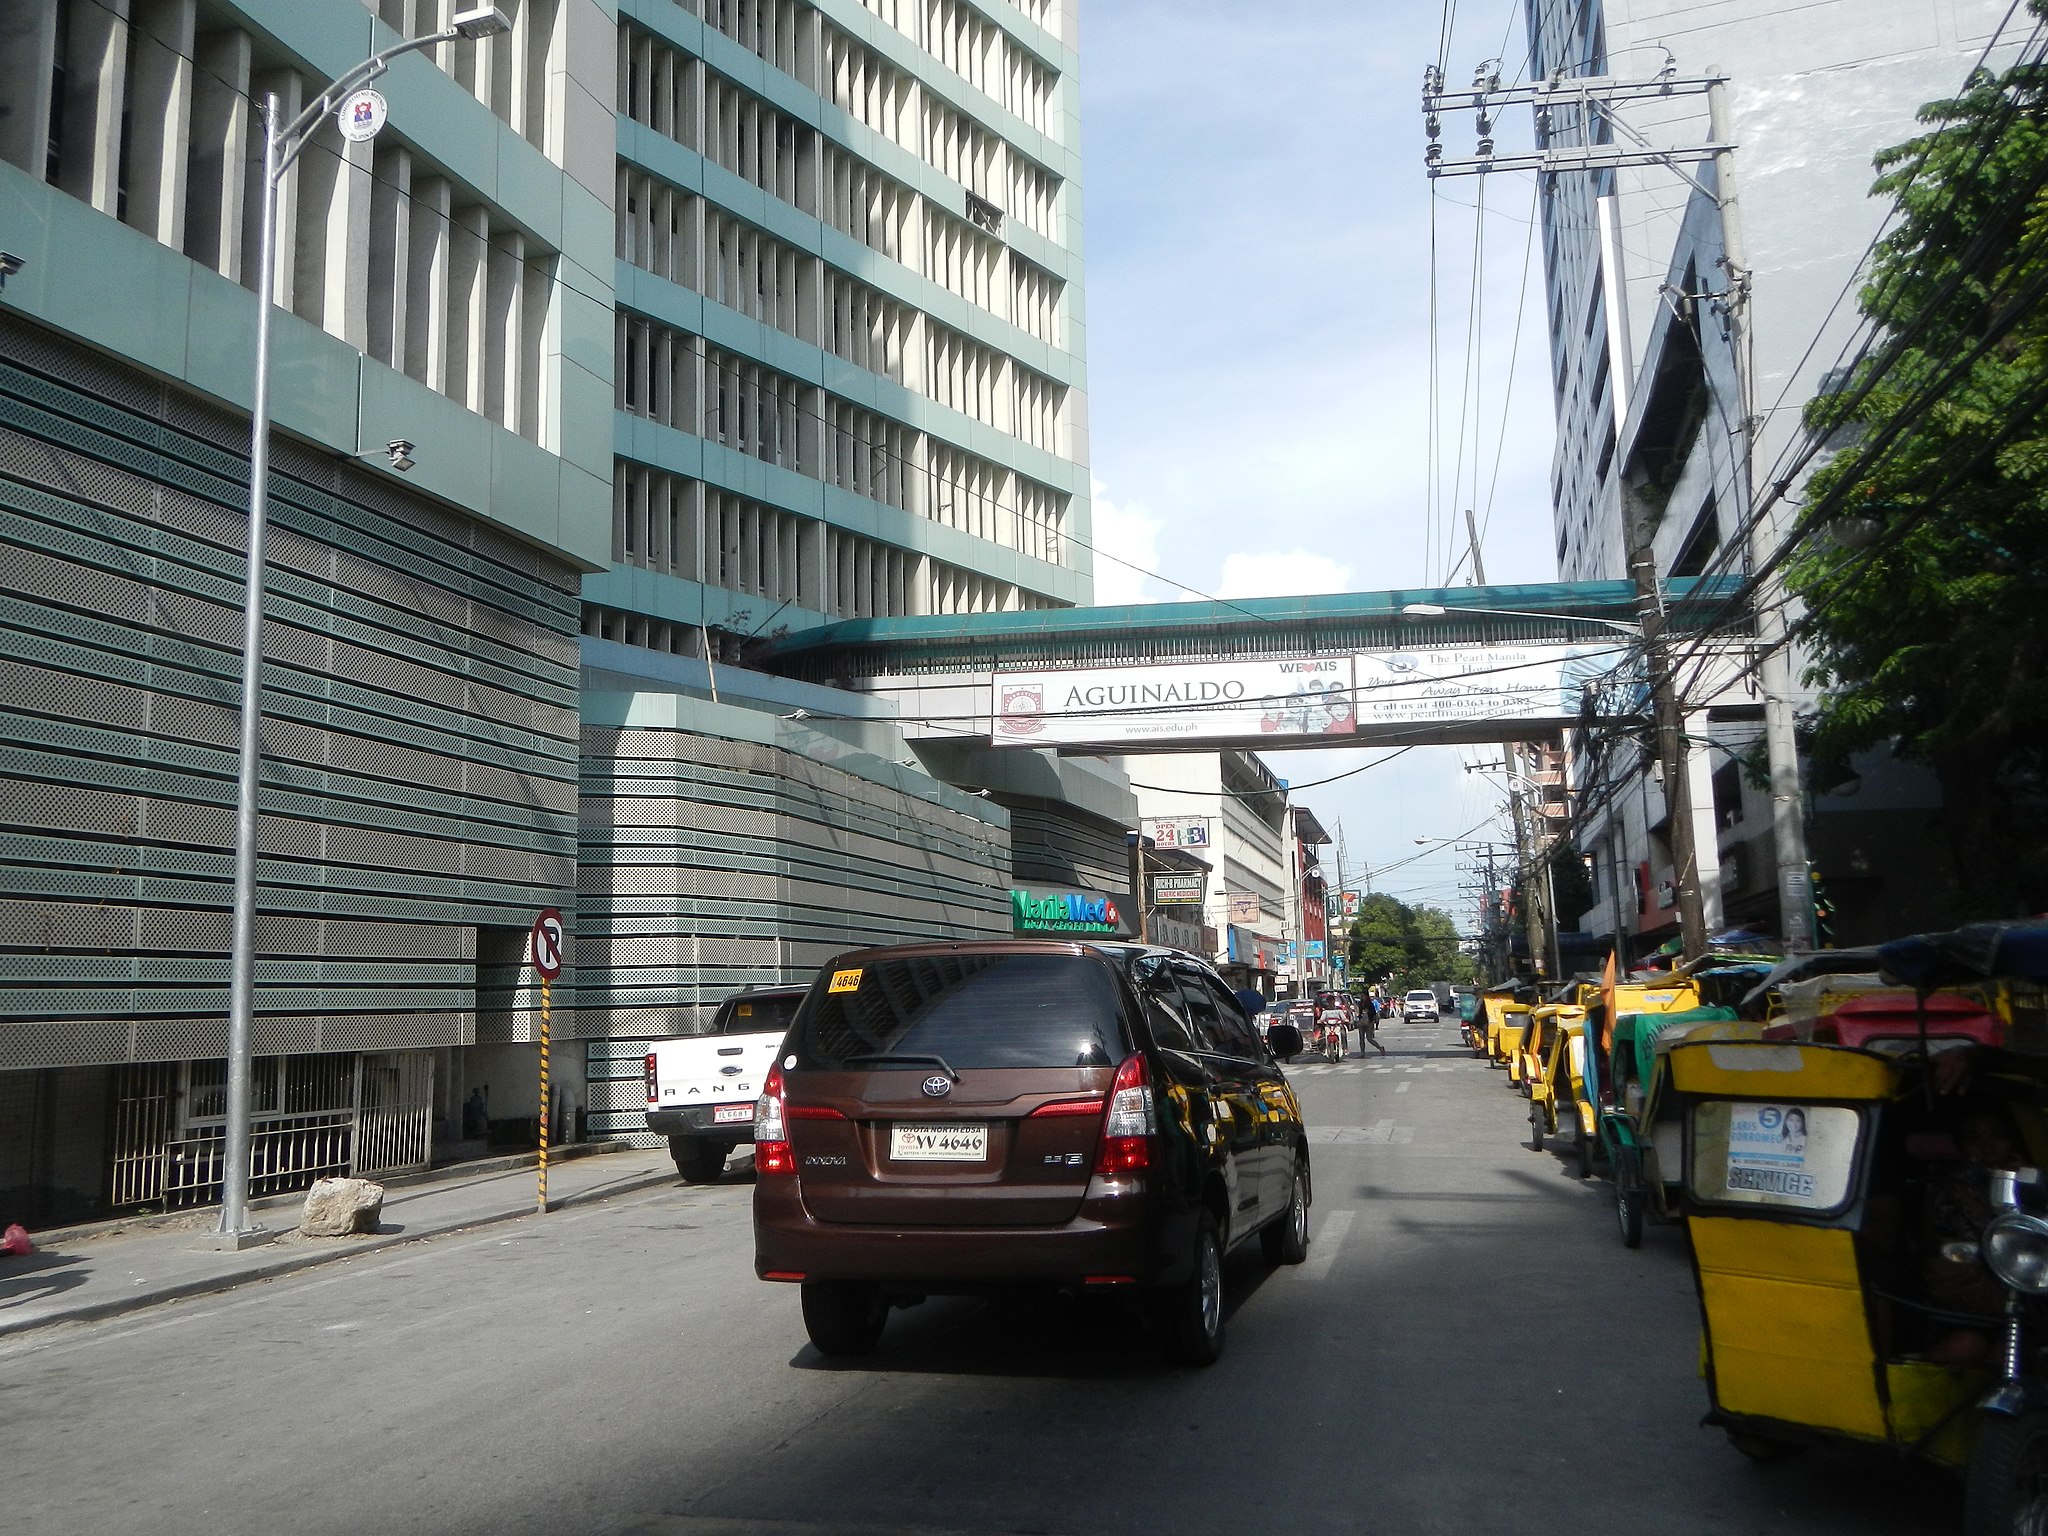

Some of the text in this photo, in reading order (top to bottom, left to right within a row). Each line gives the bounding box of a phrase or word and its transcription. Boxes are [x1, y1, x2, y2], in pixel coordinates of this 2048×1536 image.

[1427, 651, 1527, 664] The Pearl Manila
[1279, 660, 1338, 673] WE AIS
[1063, 680, 1245, 707] AGUINALDO
[1373, 703, 1397, 711] Call
[1417, 701, 1427, 709] at
[1125, 722, 1198, 734] www.ais.edu.ph
[1156, 829, 1175, 842] 24
[1008, 889, 1107, 922] ManilaMed
[836, 975, 860, 988] 4646
[939, 1134, 983, 1151] 4646
[1727, 1166, 1814, 1197] SERVICE
